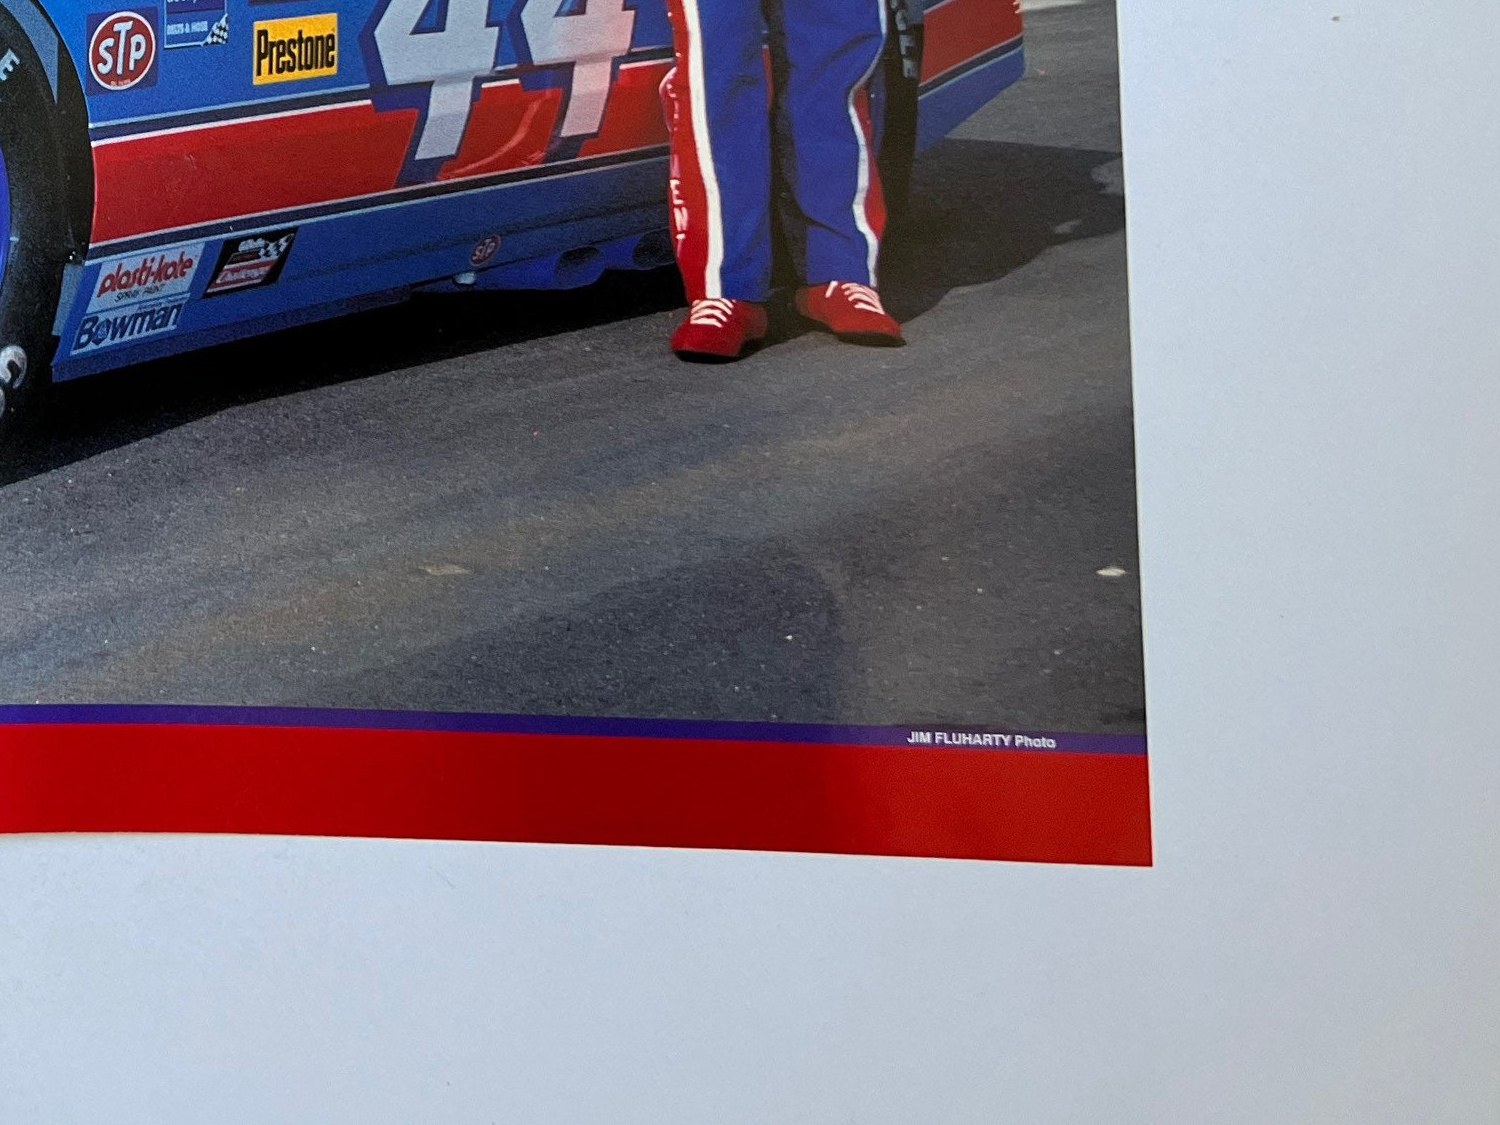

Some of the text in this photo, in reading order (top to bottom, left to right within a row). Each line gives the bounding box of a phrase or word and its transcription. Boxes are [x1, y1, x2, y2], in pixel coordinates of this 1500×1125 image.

[96, 20, 147, 76] STP
[255, 27, 337, 78] Prestone
[96, 250, 194, 299] plasti-kote
[471, 235, 499, 266] STP
[72, 303, 184, 351] Bowman
[906, 731, 1058, 750] JIM FLUHARTY Photo
